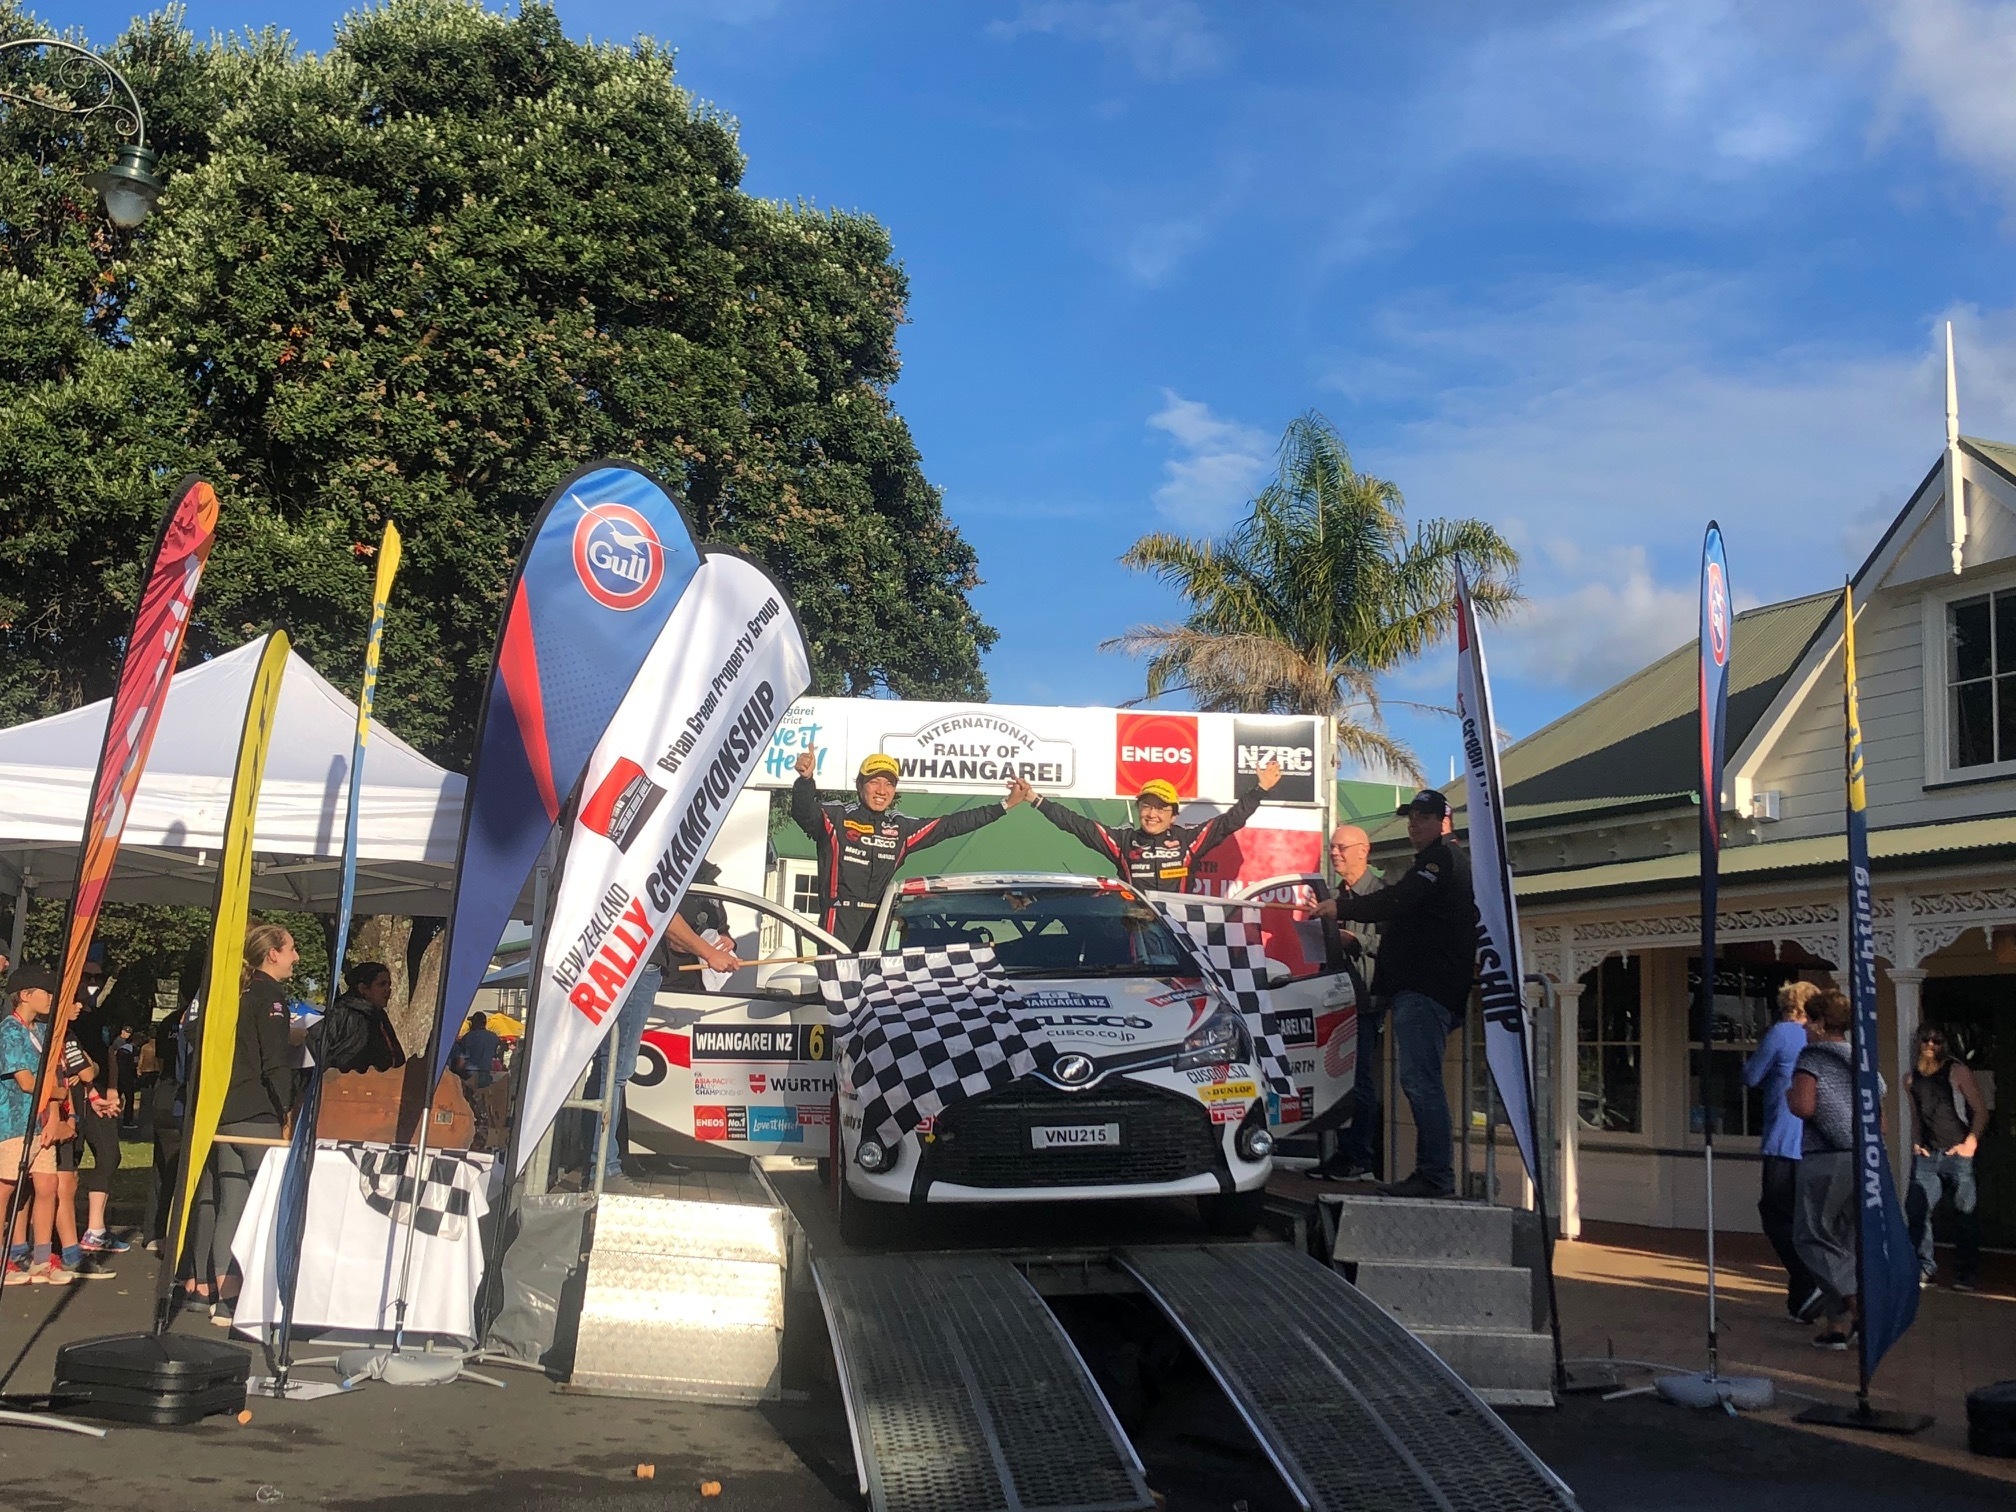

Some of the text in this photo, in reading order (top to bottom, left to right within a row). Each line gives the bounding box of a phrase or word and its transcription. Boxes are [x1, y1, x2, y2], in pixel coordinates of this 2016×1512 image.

[589, 540, 646, 585] Gull
[657, 597, 779, 774] Brian Green Property Group
[786, 706, 815, 717] gārei
[780, 717, 802, 725] trict
[773, 728, 797, 746] ve
[917, 717, 1034, 752] INTERNATIONAL
[934, 743, 1020, 759] RALLY OF
[1121, 746, 1192, 764] ENEOS
[764, 747, 828, 778] He!
[894, 758, 1062, 783] WHANGAREI
[569, 680, 774, 1026] RALLY CHAMPIONSHIP
[552, 882, 631, 993] NEW ZEALAND
[1088, 999, 1107, 1007] NZ
[695, 1032, 793, 1051] WHANGAREI NZ
[809, 1024, 825, 1060] 6
[1046, 1029, 1135, 1042] cusco.co.jp
[1186, 1066, 1224, 1083] CUSCO
[770, 1078, 833, 1092] WÜRTH
[1212, 1086, 1252, 1096] DUNLOP
[696, 1119, 724, 1127] ENEOS
[728, 1118, 746, 1127] No.1
[1045, 1129, 1107, 1142] VNU215
